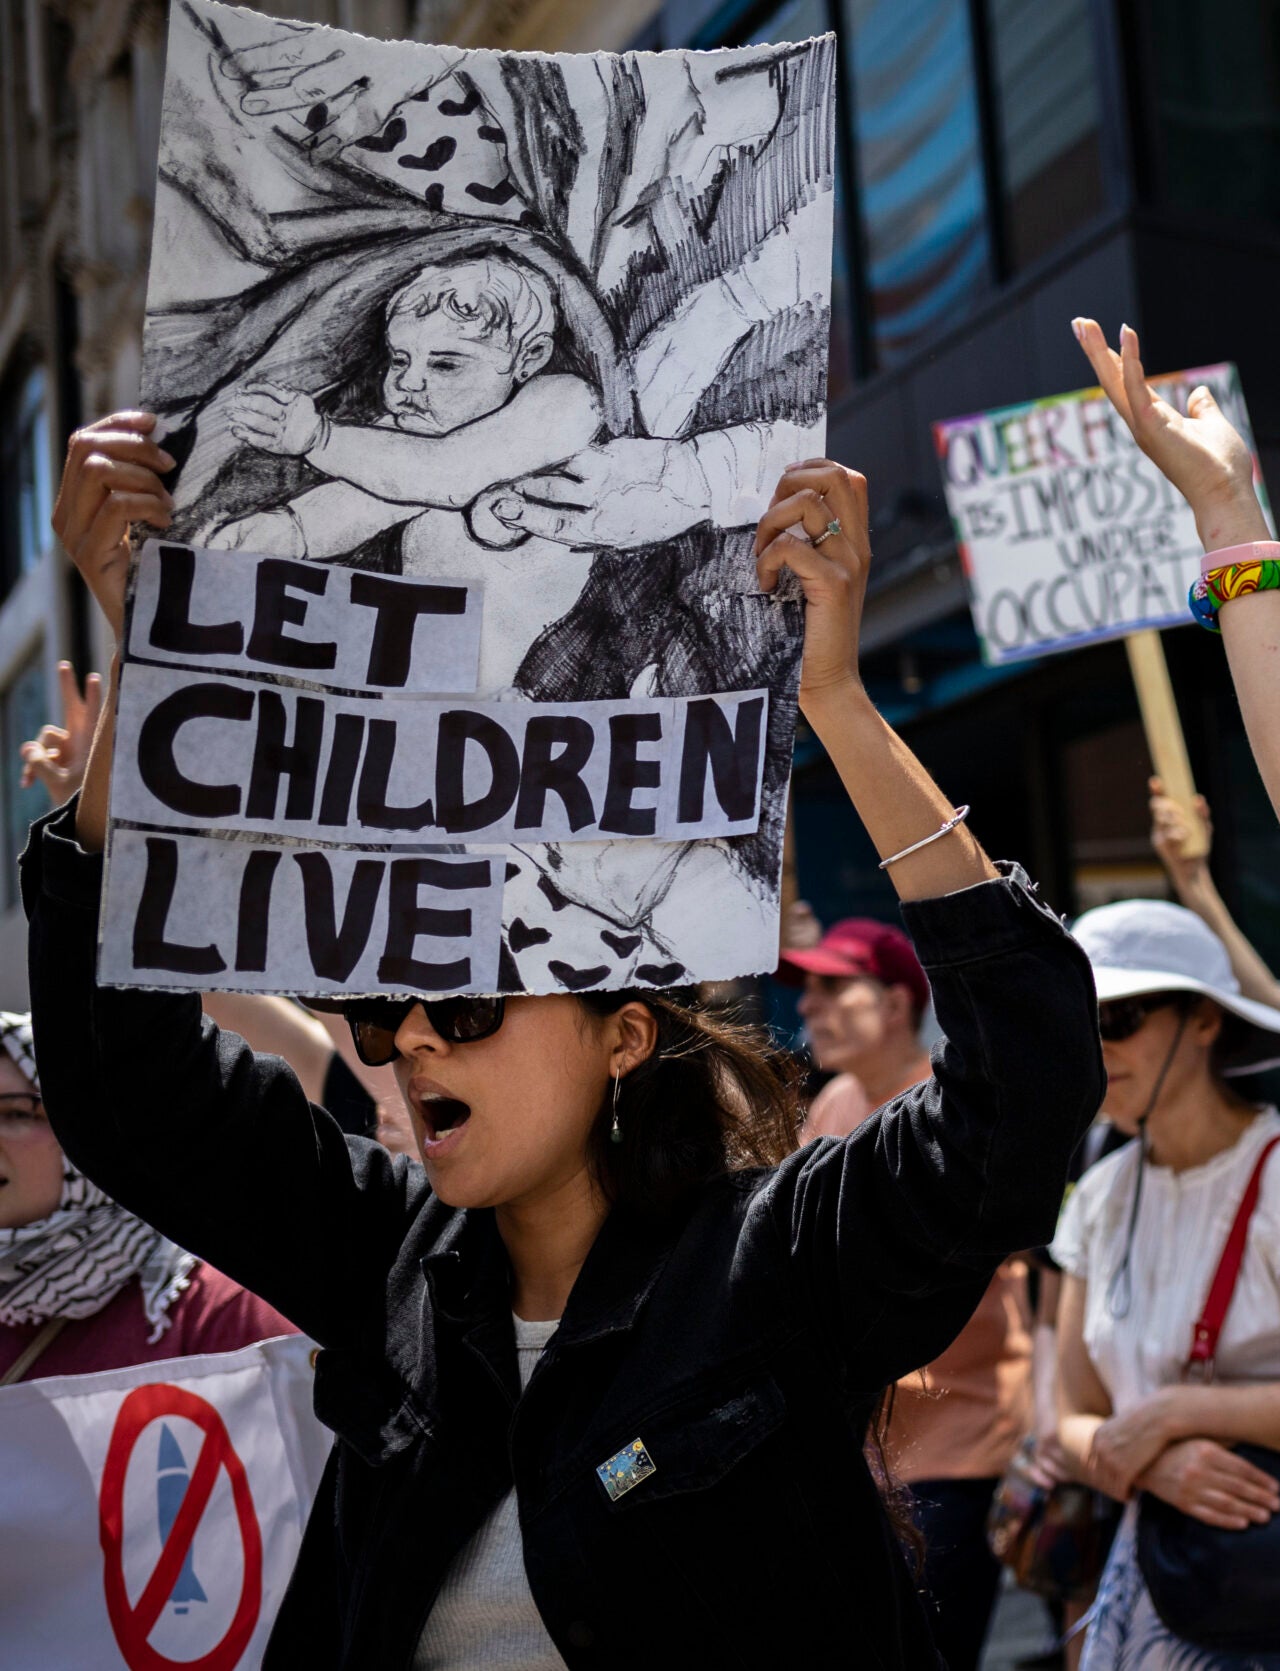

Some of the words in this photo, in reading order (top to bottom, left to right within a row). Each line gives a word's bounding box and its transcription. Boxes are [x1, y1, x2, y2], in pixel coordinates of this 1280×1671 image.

[948, 404, 1077, 488] QUEER
[962, 499, 1006, 541] IS
[1005, 459, 1194, 544] IMPOSSI
[1057, 514, 1179, 569] UNDER
[148, 546, 468, 687] LET
[988, 548, 1204, 649] OCCUPAT
[137, 683, 765, 836] CHILDREN
[132, 837, 492, 988] LIVE
